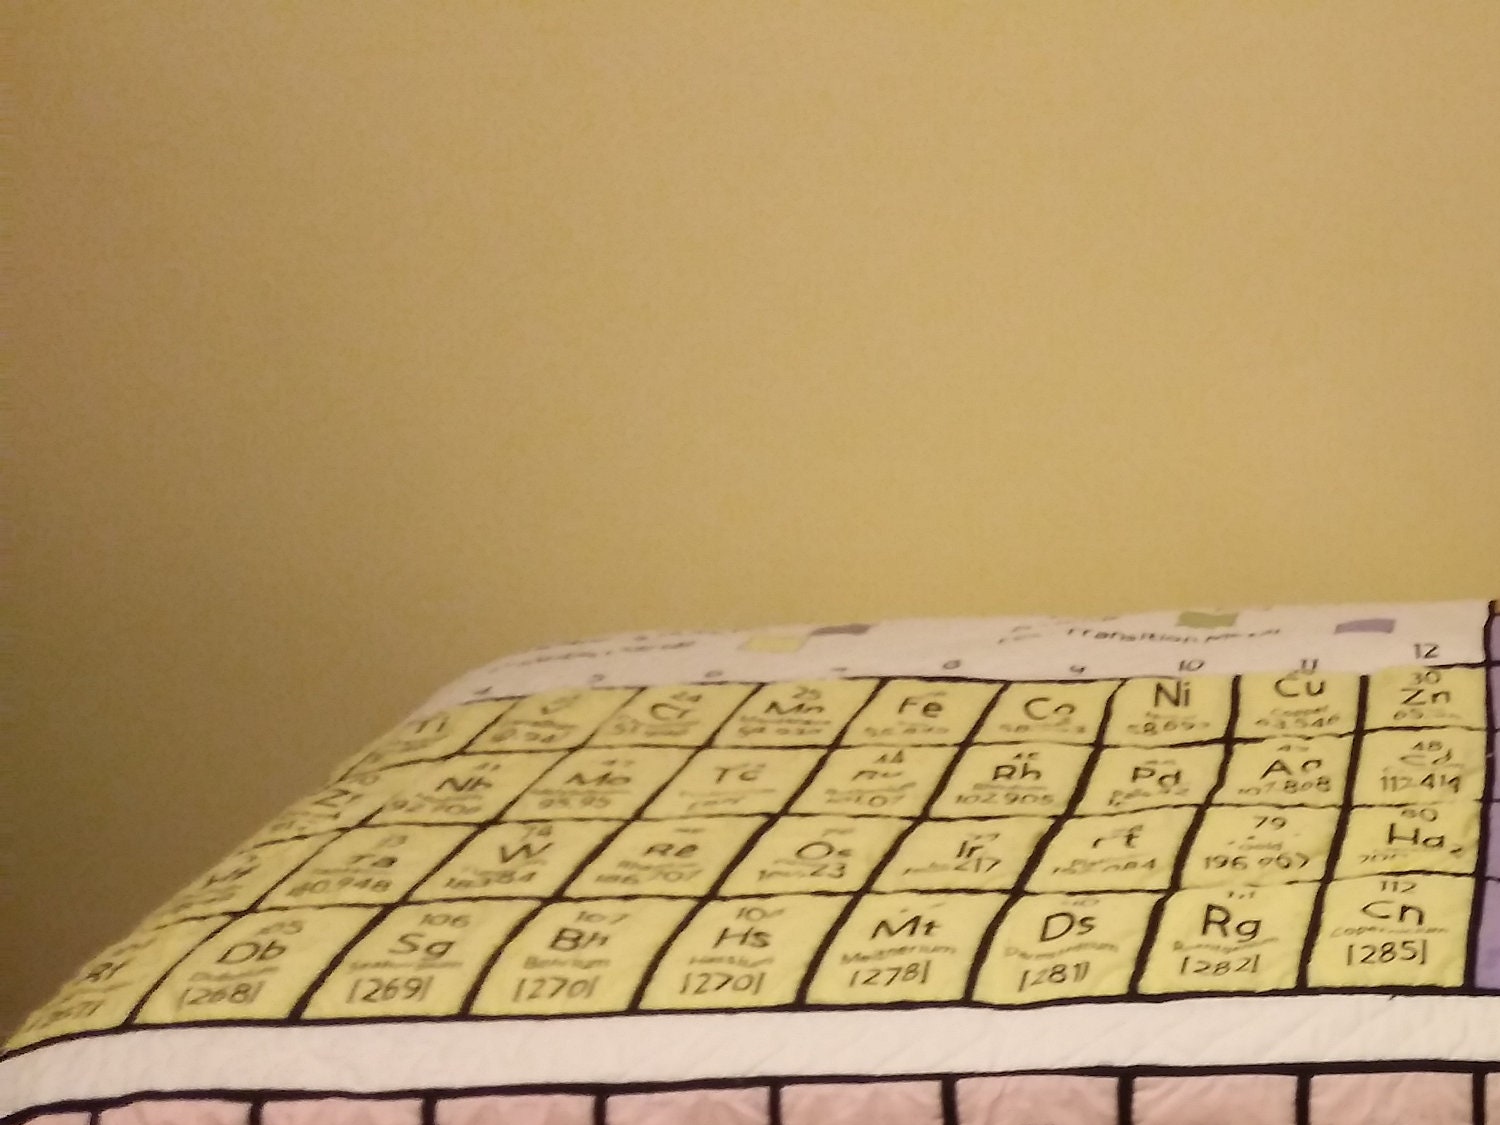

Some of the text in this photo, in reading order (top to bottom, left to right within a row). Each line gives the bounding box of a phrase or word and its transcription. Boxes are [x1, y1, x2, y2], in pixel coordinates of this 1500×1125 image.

[1414, 643, 1440, 659] 12
[1154, 681, 1190, 707] Ni
[1274, 677, 1326, 698] Cu
[1401, 687, 1451, 706] Zn
[1201, 904, 1262, 943] Rg
[1361, 900, 1425, 926] Cn
[1039, 911, 1096, 943] Ds
[1346, 938, 1428, 967] [285]
